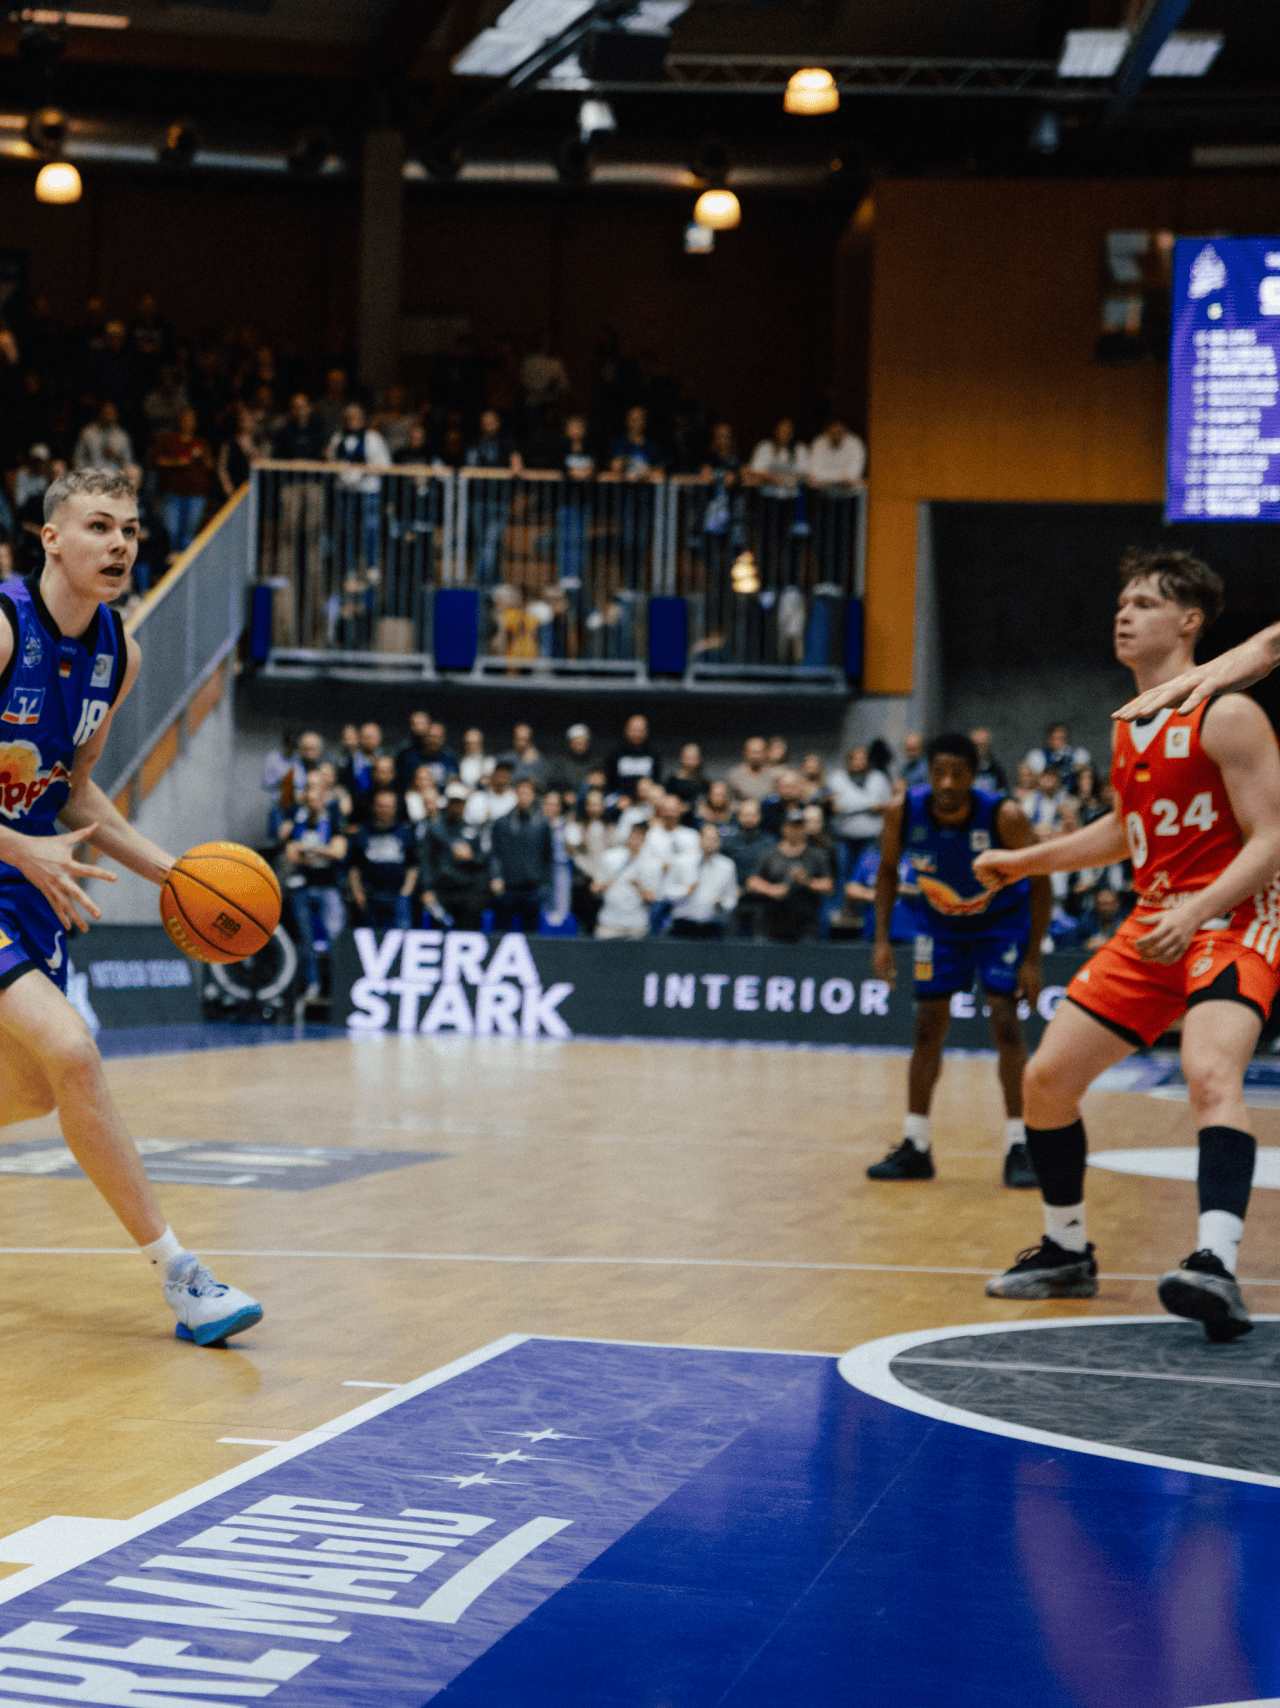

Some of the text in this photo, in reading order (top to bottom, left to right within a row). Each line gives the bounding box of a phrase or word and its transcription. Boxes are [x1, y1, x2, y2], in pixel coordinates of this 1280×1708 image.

[1150, 791, 1219, 837] 24
[353, 926, 541, 985] VERA
[346, 976, 575, 1038] STARK
[643, 972, 891, 1016] INTERIOR
[52, 1493, 498, 1644] MAGIC
